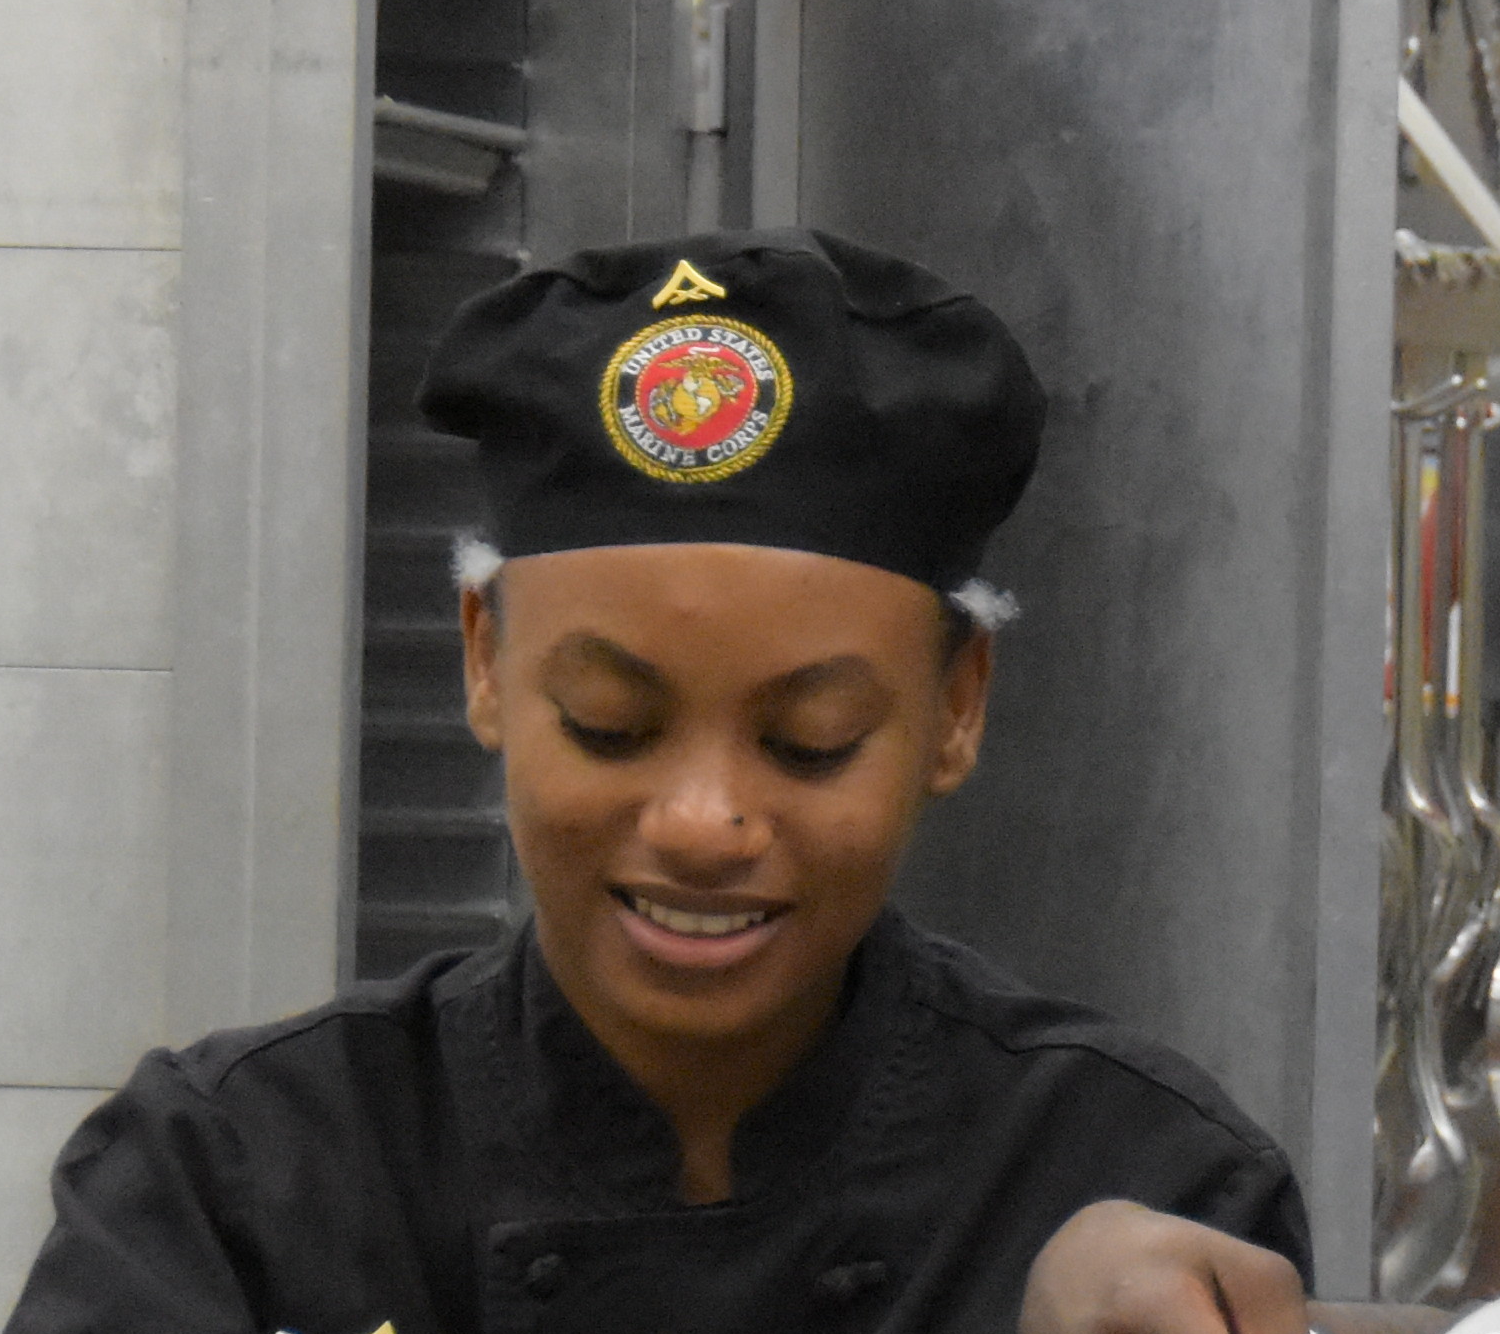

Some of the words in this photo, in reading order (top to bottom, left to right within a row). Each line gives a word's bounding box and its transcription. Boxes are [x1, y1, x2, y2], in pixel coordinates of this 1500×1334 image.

[622, 327, 702, 375] UNITED
[707, 328, 775, 381] STATES
[619, 404, 696, 466] MARINE
[706, 410, 769, 462] CORPS
